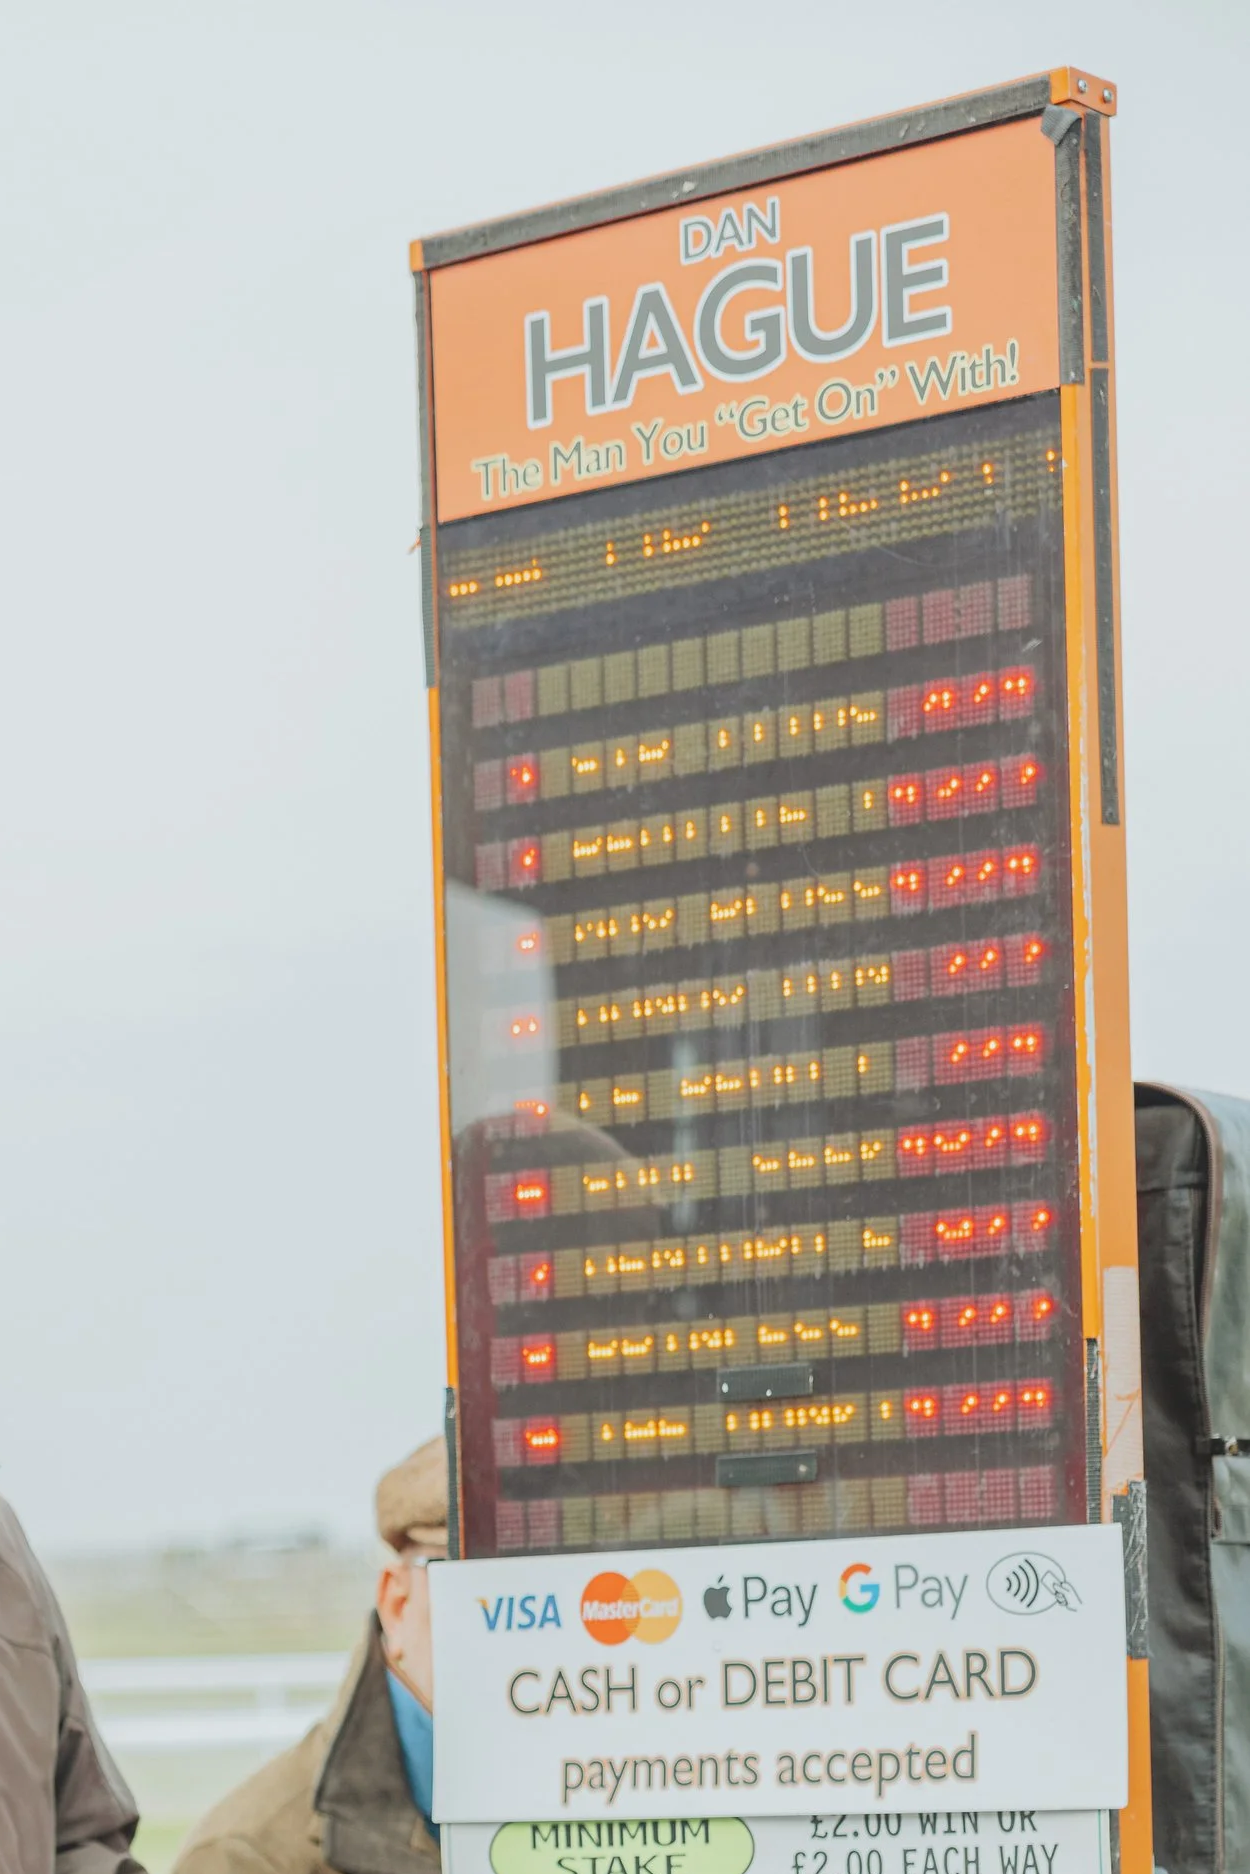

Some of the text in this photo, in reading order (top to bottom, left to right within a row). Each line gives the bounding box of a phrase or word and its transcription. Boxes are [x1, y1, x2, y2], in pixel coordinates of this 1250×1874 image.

[681, 198, 780, 264] DAN
[525, 213, 952, 428] HAGUE
[472, 452, 541, 501] The
[551, 435, 624, 482] Man
[635, 420, 707, 462] You
[908, 341, 1020, 402] With!
[477, 1594, 562, 1631] VISA
[582, 1598, 679, 1621] MasterCard
[742, 1575, 818, 1627] Pay
[894, 1563, 969, 1619] Pay
[507, 1647, 1039, 1716] CASH or DEBIT CARD
[561, 1731, 979, 1807] payments accepted
[531, 1819, 710, 1850] MINIMUM
[918, 1812, 979, 1836] WIN
[997, 1811, 1038, 1834] OR
